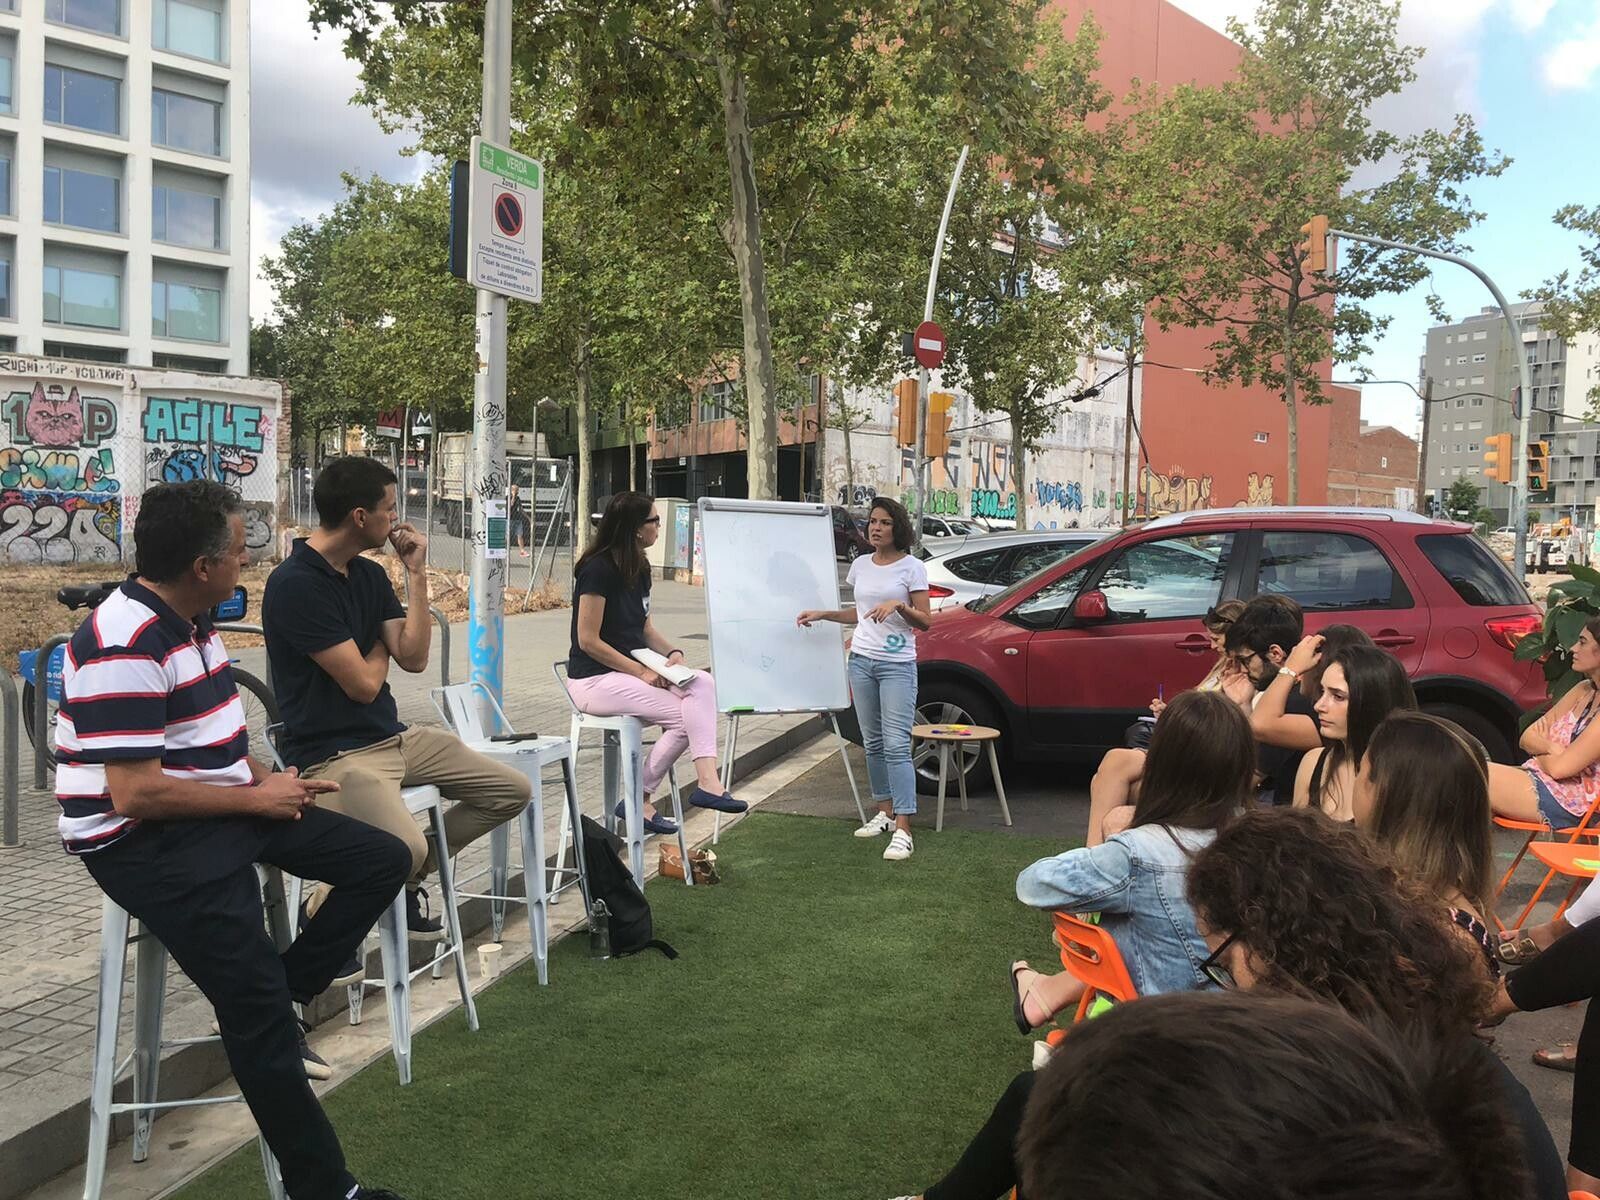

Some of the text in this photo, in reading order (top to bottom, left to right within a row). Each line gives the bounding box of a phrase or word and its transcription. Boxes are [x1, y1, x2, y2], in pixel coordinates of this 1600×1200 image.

[506, 155, 528, 175] VERDA
[502, 178, 514, 188] Zona
[143, 397, 265, 453] AGILE
[416, 411, 433, 425] M
